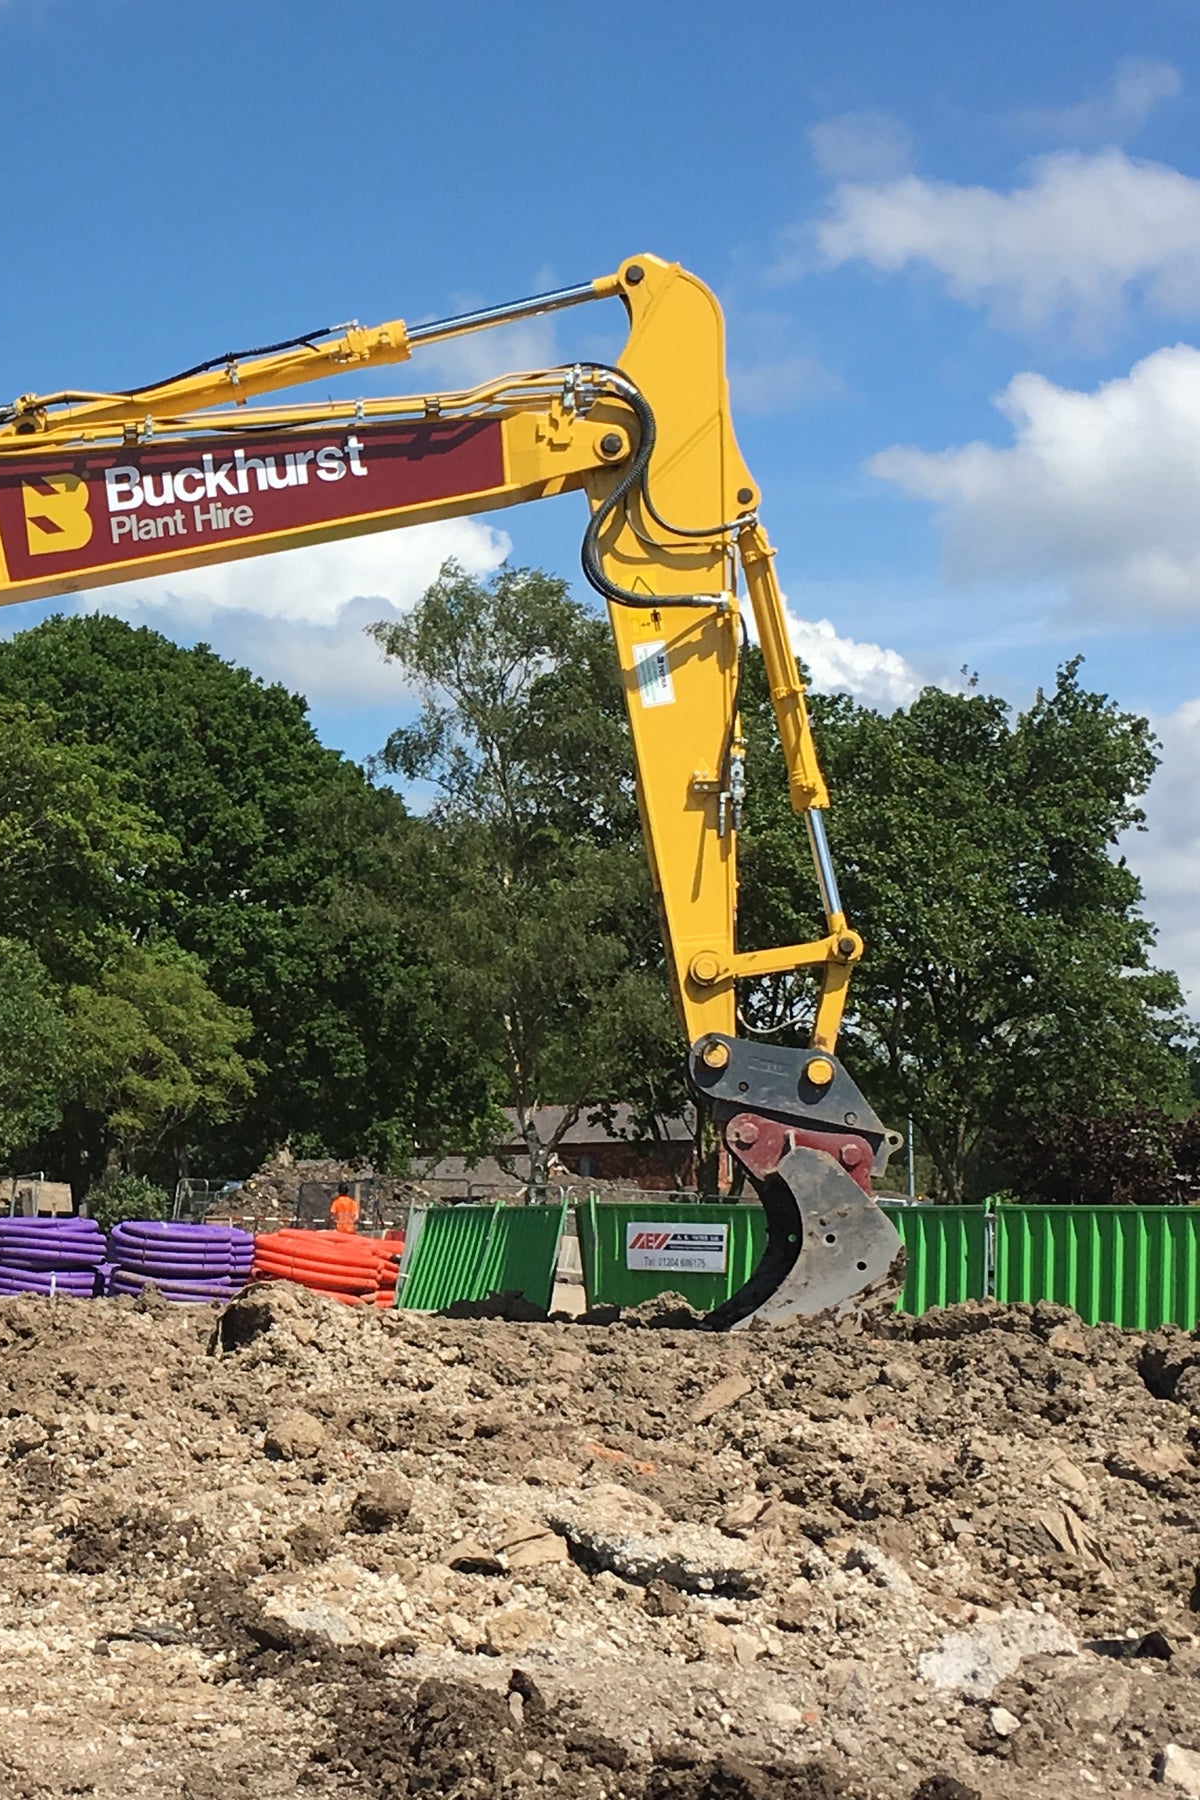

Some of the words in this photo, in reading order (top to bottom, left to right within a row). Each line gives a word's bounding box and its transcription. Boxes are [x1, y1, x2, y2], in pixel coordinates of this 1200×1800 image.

[105, 435, 368, 512] Buckhurst
[110, 509, 187, 544] Plant
[194, 502, 254, 533] Hire
